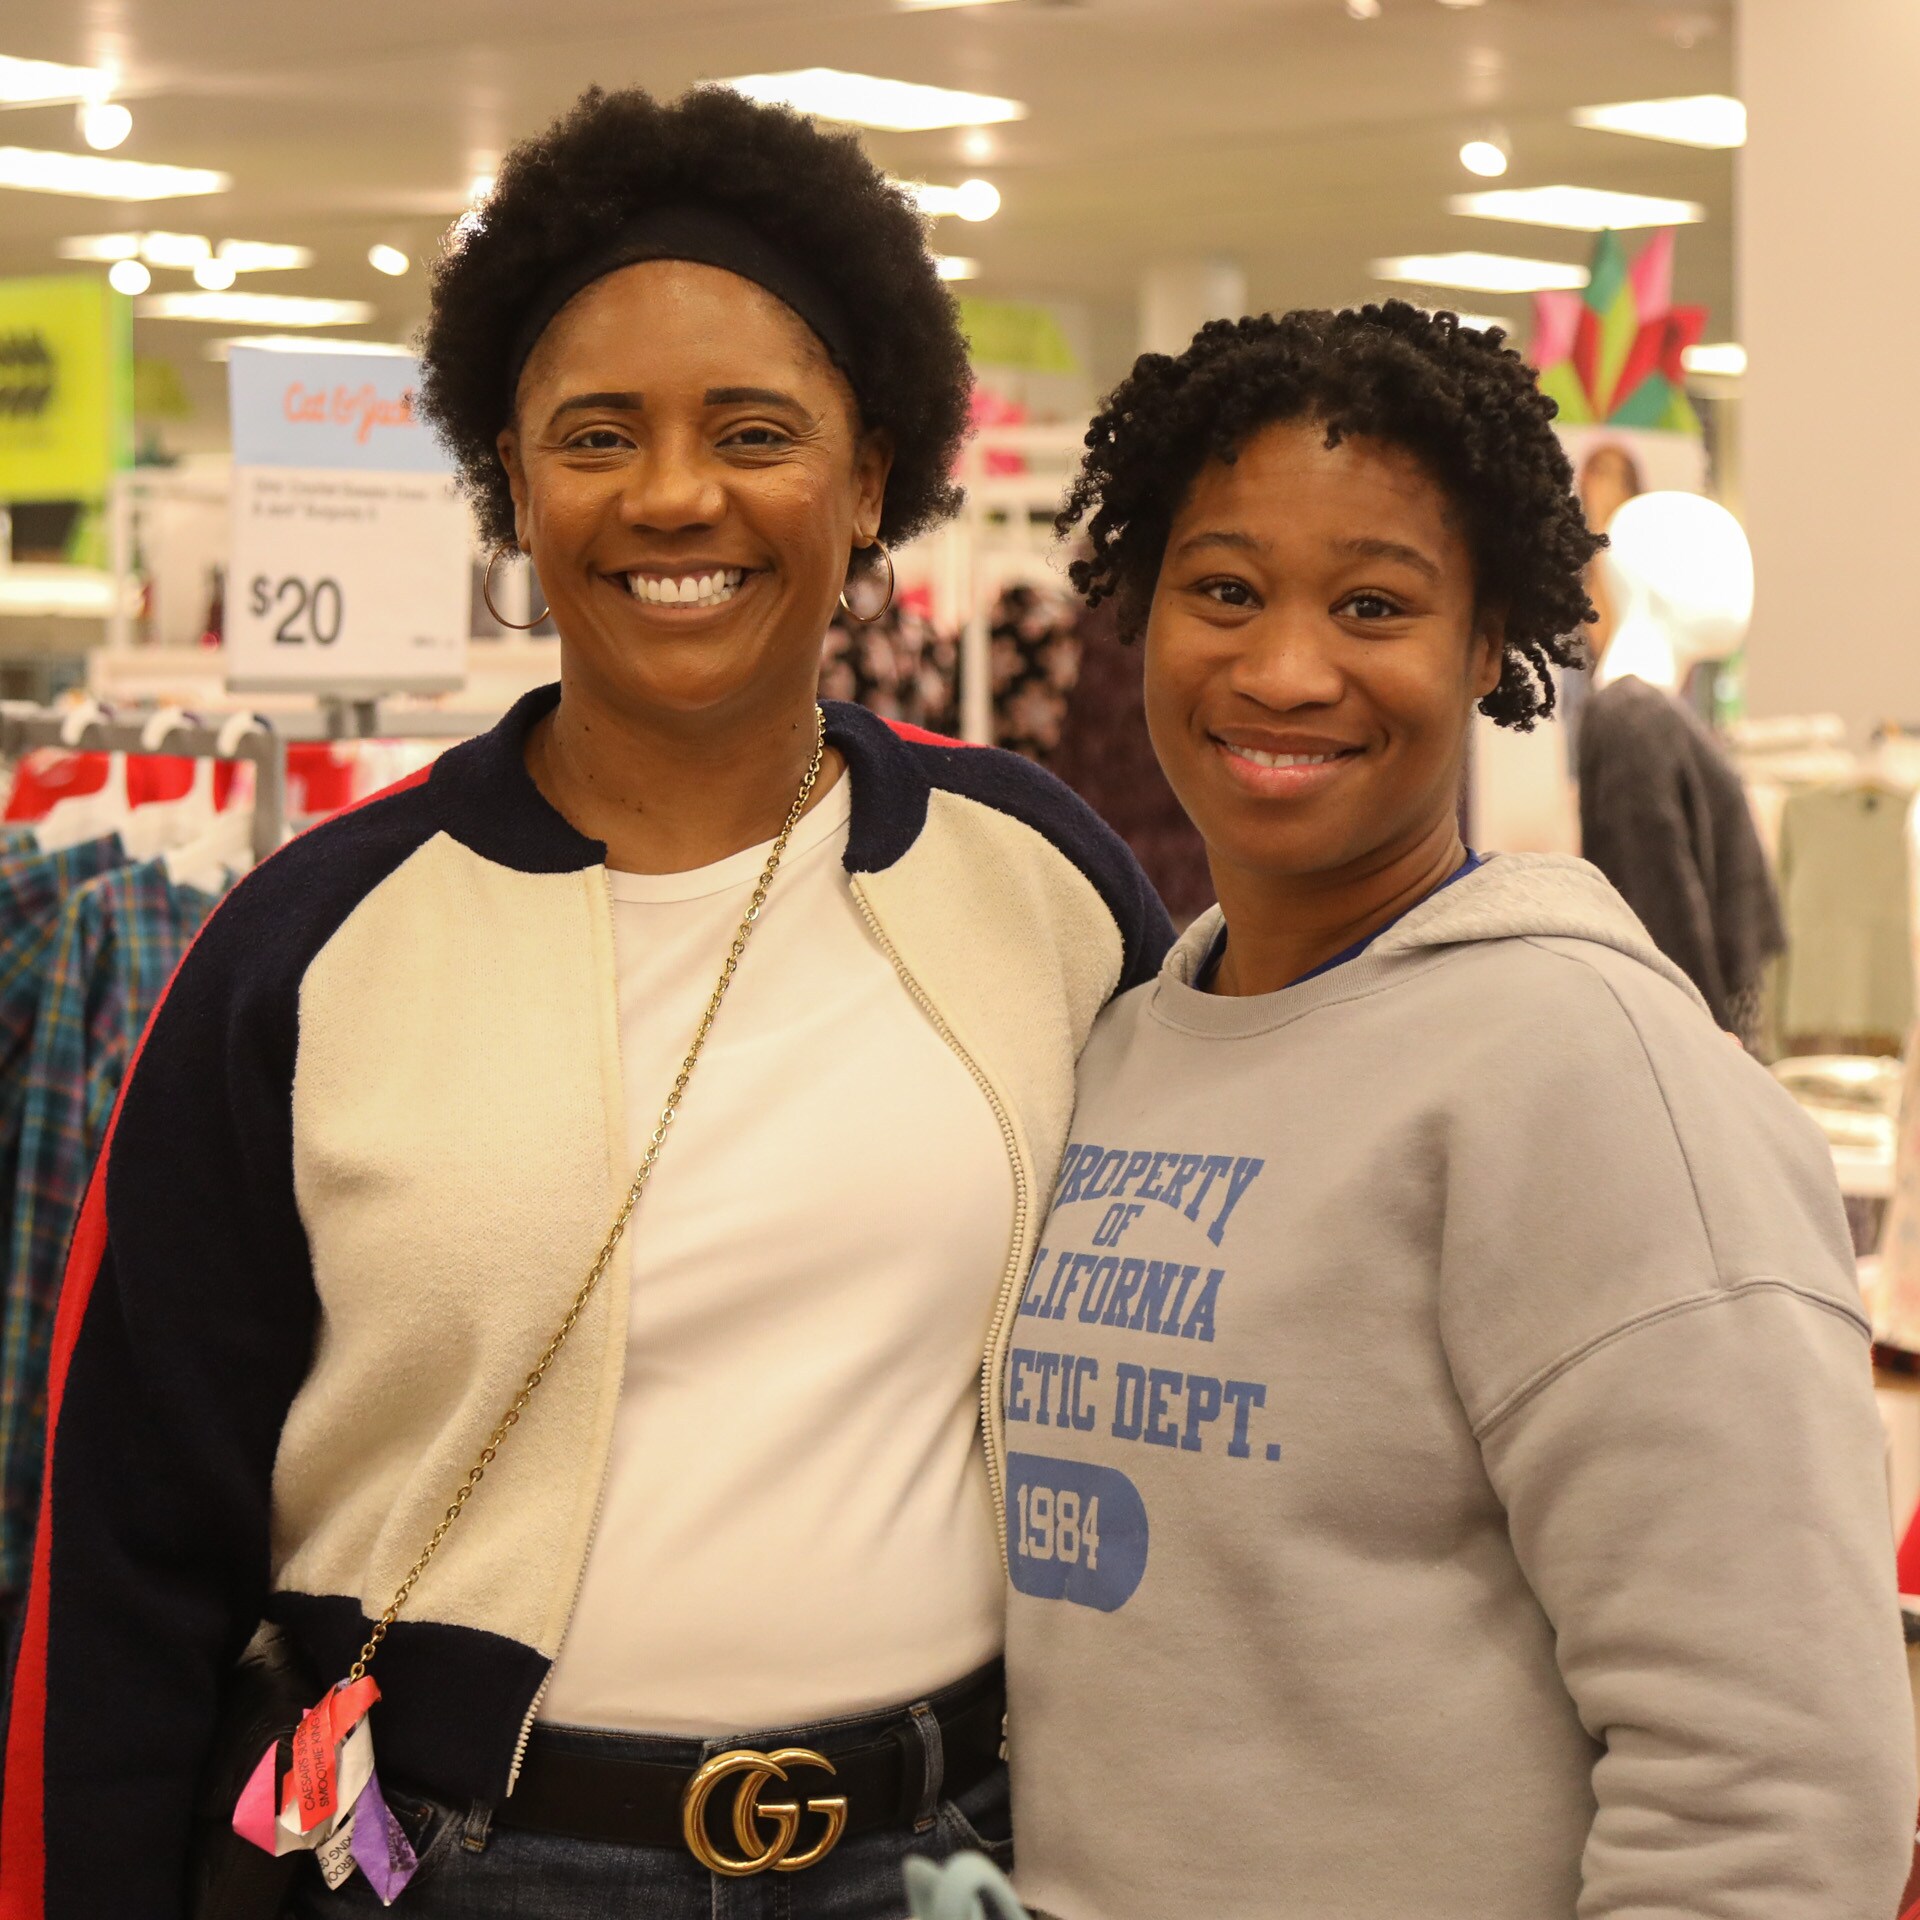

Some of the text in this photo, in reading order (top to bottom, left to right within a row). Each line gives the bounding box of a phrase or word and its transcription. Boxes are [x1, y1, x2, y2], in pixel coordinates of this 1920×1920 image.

[251, 576, 343, 645] $20
[1053, 1144, 1265, 1248] PROPERTY
[1091, 1202, 1146, 1247] OF
[1019, 1248, 1226, 1342] LIFORNIA
[1007, 1348, 1282, 1461] ETIC DEPT.
[1017, 1484, 1100, 1571] 1984
[311, 1717, 322, 1745] KING
[313, 1747, 330, 1807] SMOOTHIE
[329, 1836, 352, 1861] KING
